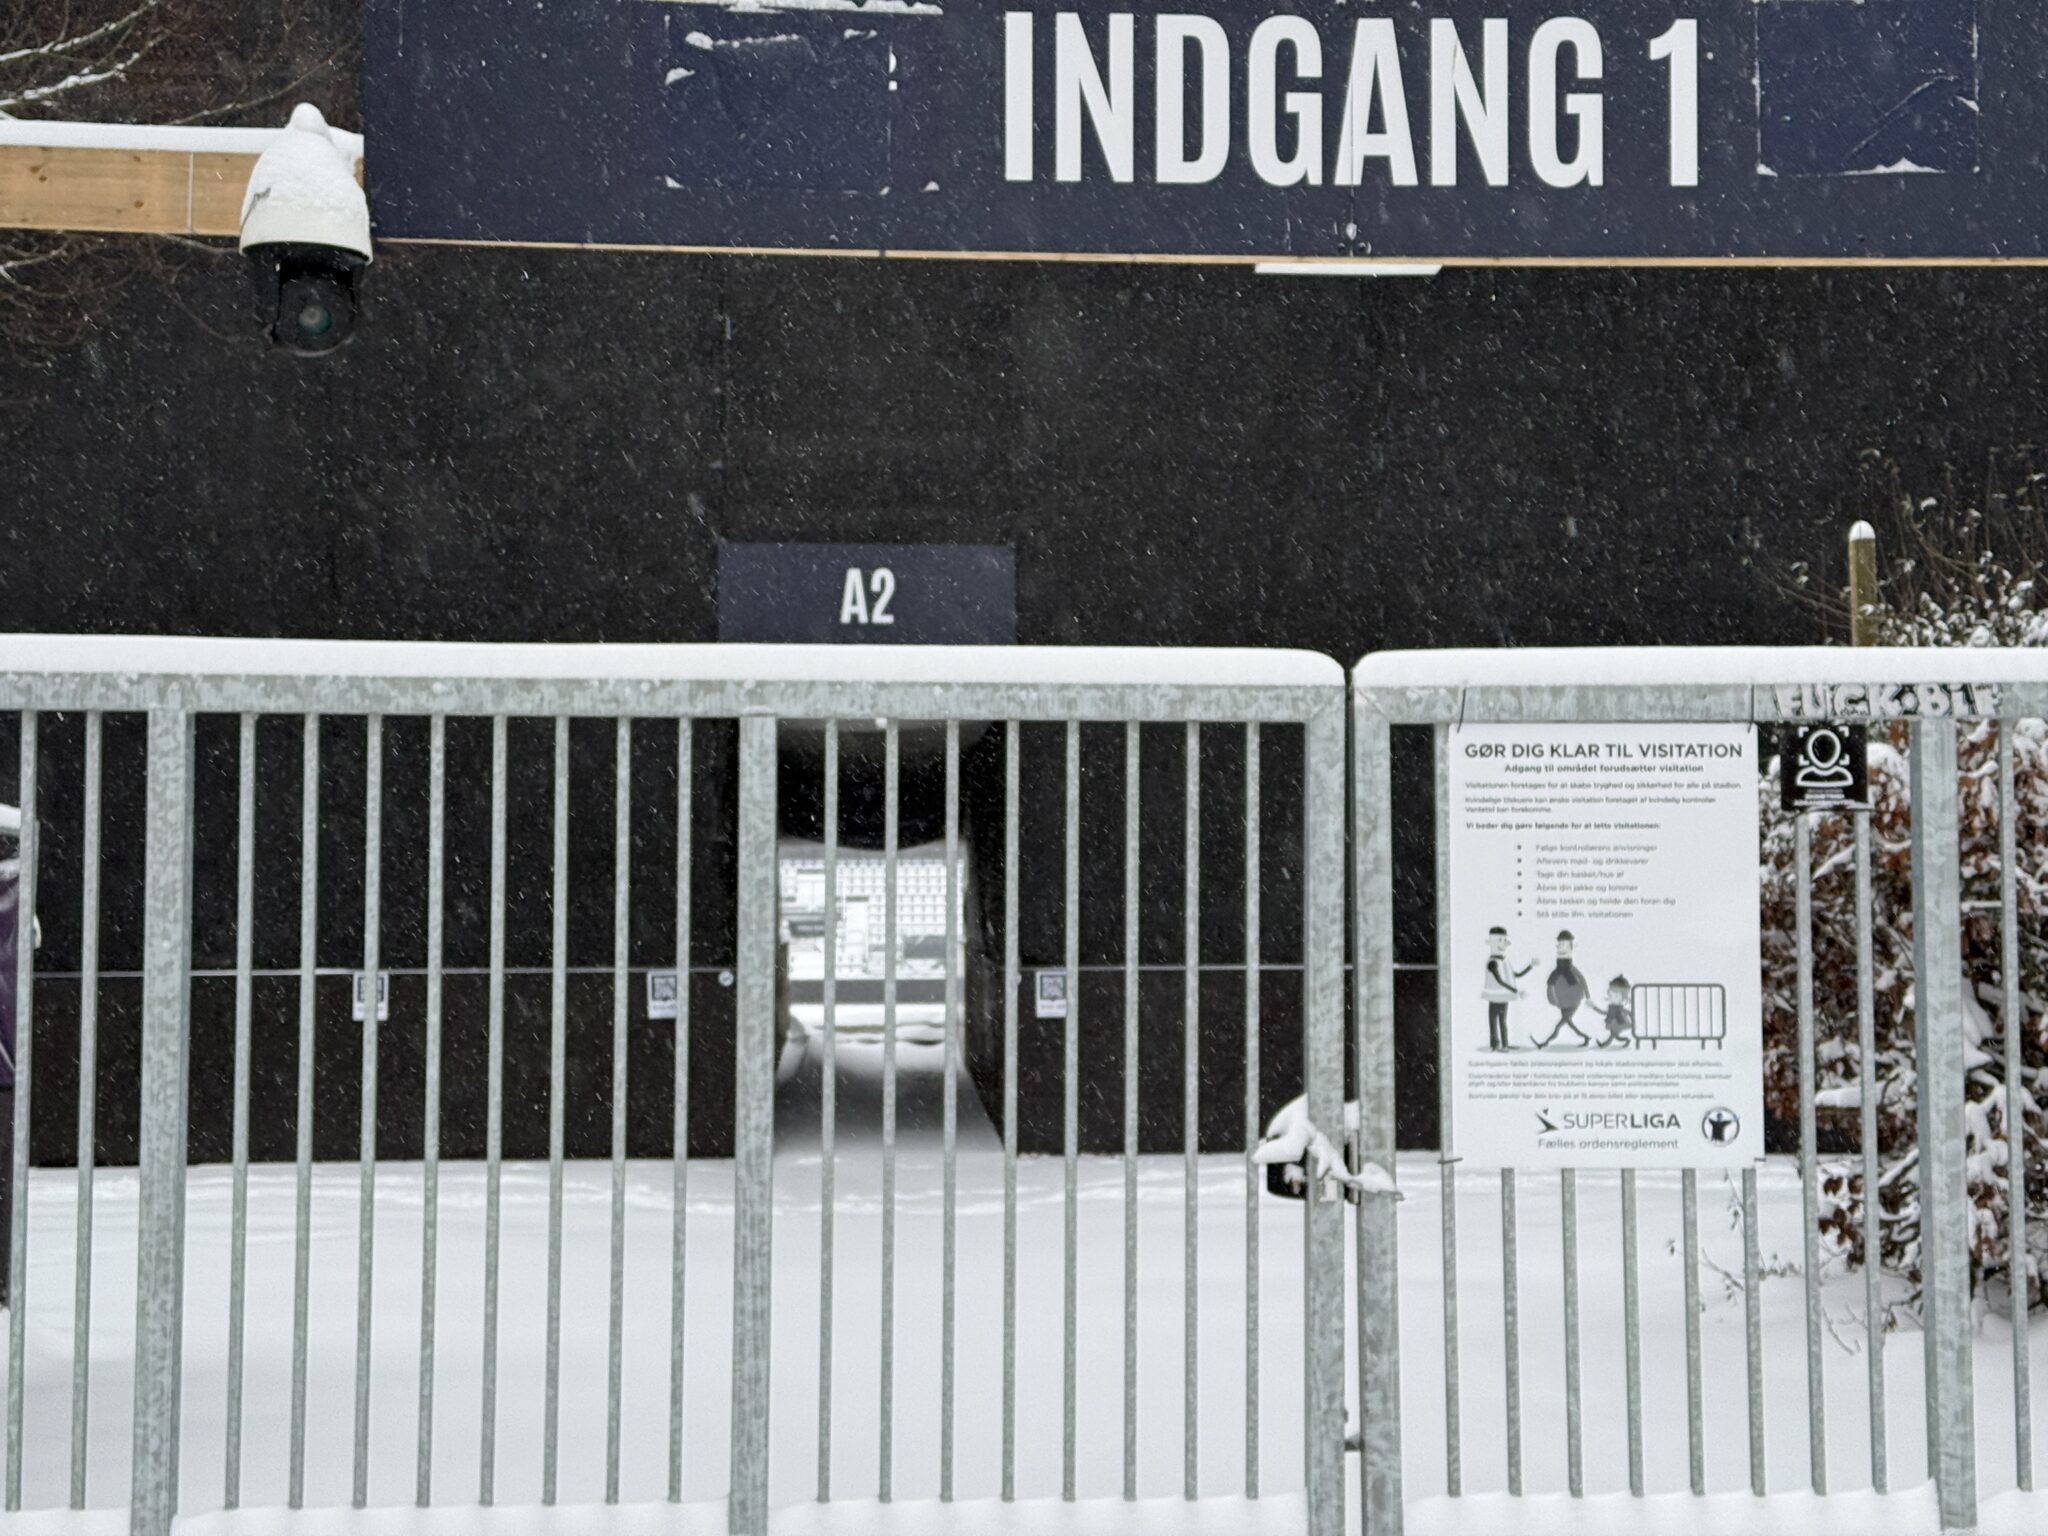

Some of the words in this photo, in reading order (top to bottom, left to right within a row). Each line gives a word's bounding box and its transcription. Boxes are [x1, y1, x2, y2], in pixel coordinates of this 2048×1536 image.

[1005, 11, 1603, 187] INDGANG
[1649, 18, 1698, 187] 1
[840, 567, 896, 624] A2
[1464, 743, 1506, 759] GØR
[1512, 743, 1544, 759] DIG
[1550, 743, 1600, 759] KLAR
[1606, 743, 1633, 759] TIL
[1638, 743, 1742, 759] VISITATION
[1504, 764, 1542, 774] Adgang
[1544, 764, 1554, 774] til
[1556, 764, 1597, 774] området
[1599, 764, 1656, 774] forudsætter
[1659, 764, 1704, 774] visitation
[1547, 781, 1558, 791] for
[1593, 781, 1623, 791] tryghed
[1624, 781, 1635, 791] og
[1674, 781, 1684, 791] for
[1466, 822, 1474, 831] Vi
[1476, 822, 1498, 831] beder
[1500, 822, 1513, 831] dig
[1515, 822, 1532, 831] gøre
[1534, 822, 1569, 831] følgende
[1571, 822, 1582, 831] for
[1584, 822, 1592, 831] at
[1592, 857, 1604, 866] og
[1556, 871, 1569, 879] din
[1559, 883, 1572, 893] din
[1596, 883, 1606, 893] og
[1587, 897, 1598, 906] og
[1663, 897, 1676, 906] dig
[1563, 1113, 1681, 1129] SUPERLIGA
[1538, 1138, 1575, 1149] Fælles
[1579, 1138, 1678, 1151] ordensreglement
